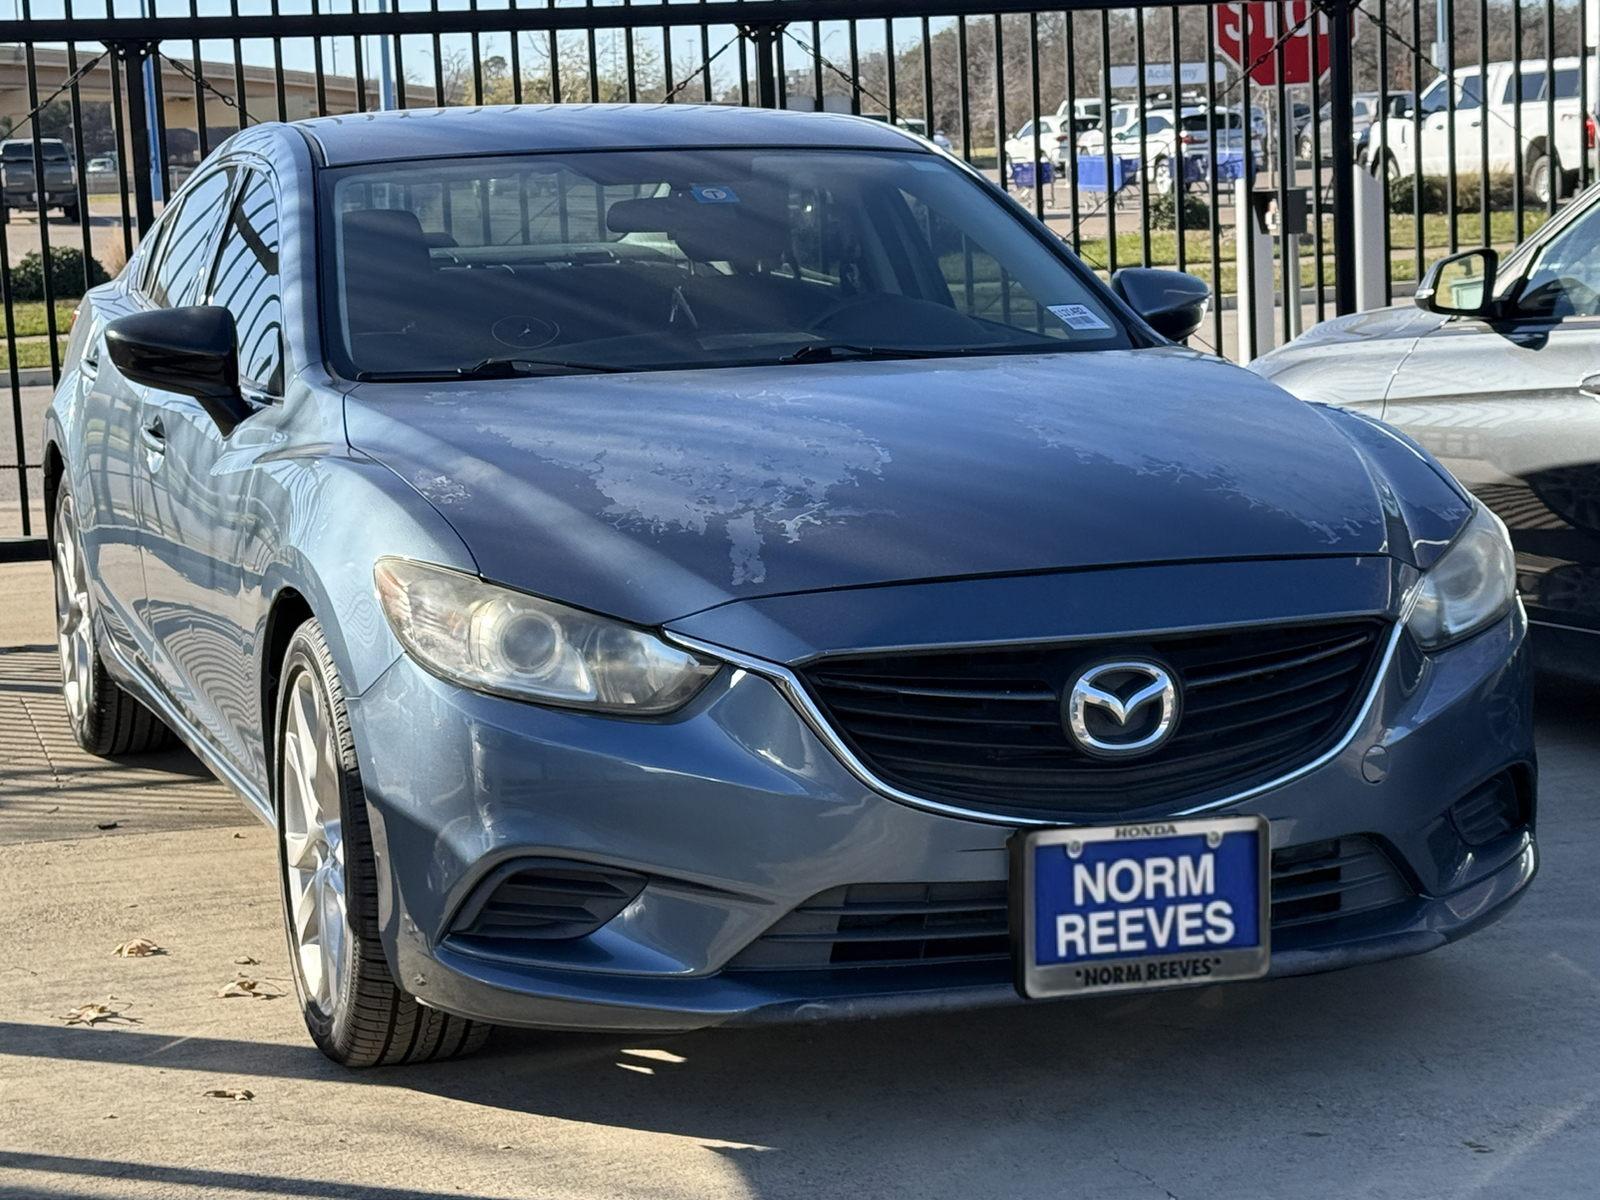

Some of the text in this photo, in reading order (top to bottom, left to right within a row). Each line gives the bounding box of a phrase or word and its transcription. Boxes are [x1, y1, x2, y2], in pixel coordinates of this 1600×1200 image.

[1225, 2, 1329, 41] STO
[1147, 68, 1198, 80] Acadmy
[1115, 824, 1178, 839] HONDA
[1073, 853, 1215, 906] NORM
[1056, 900, 1236, 957] REEVES
